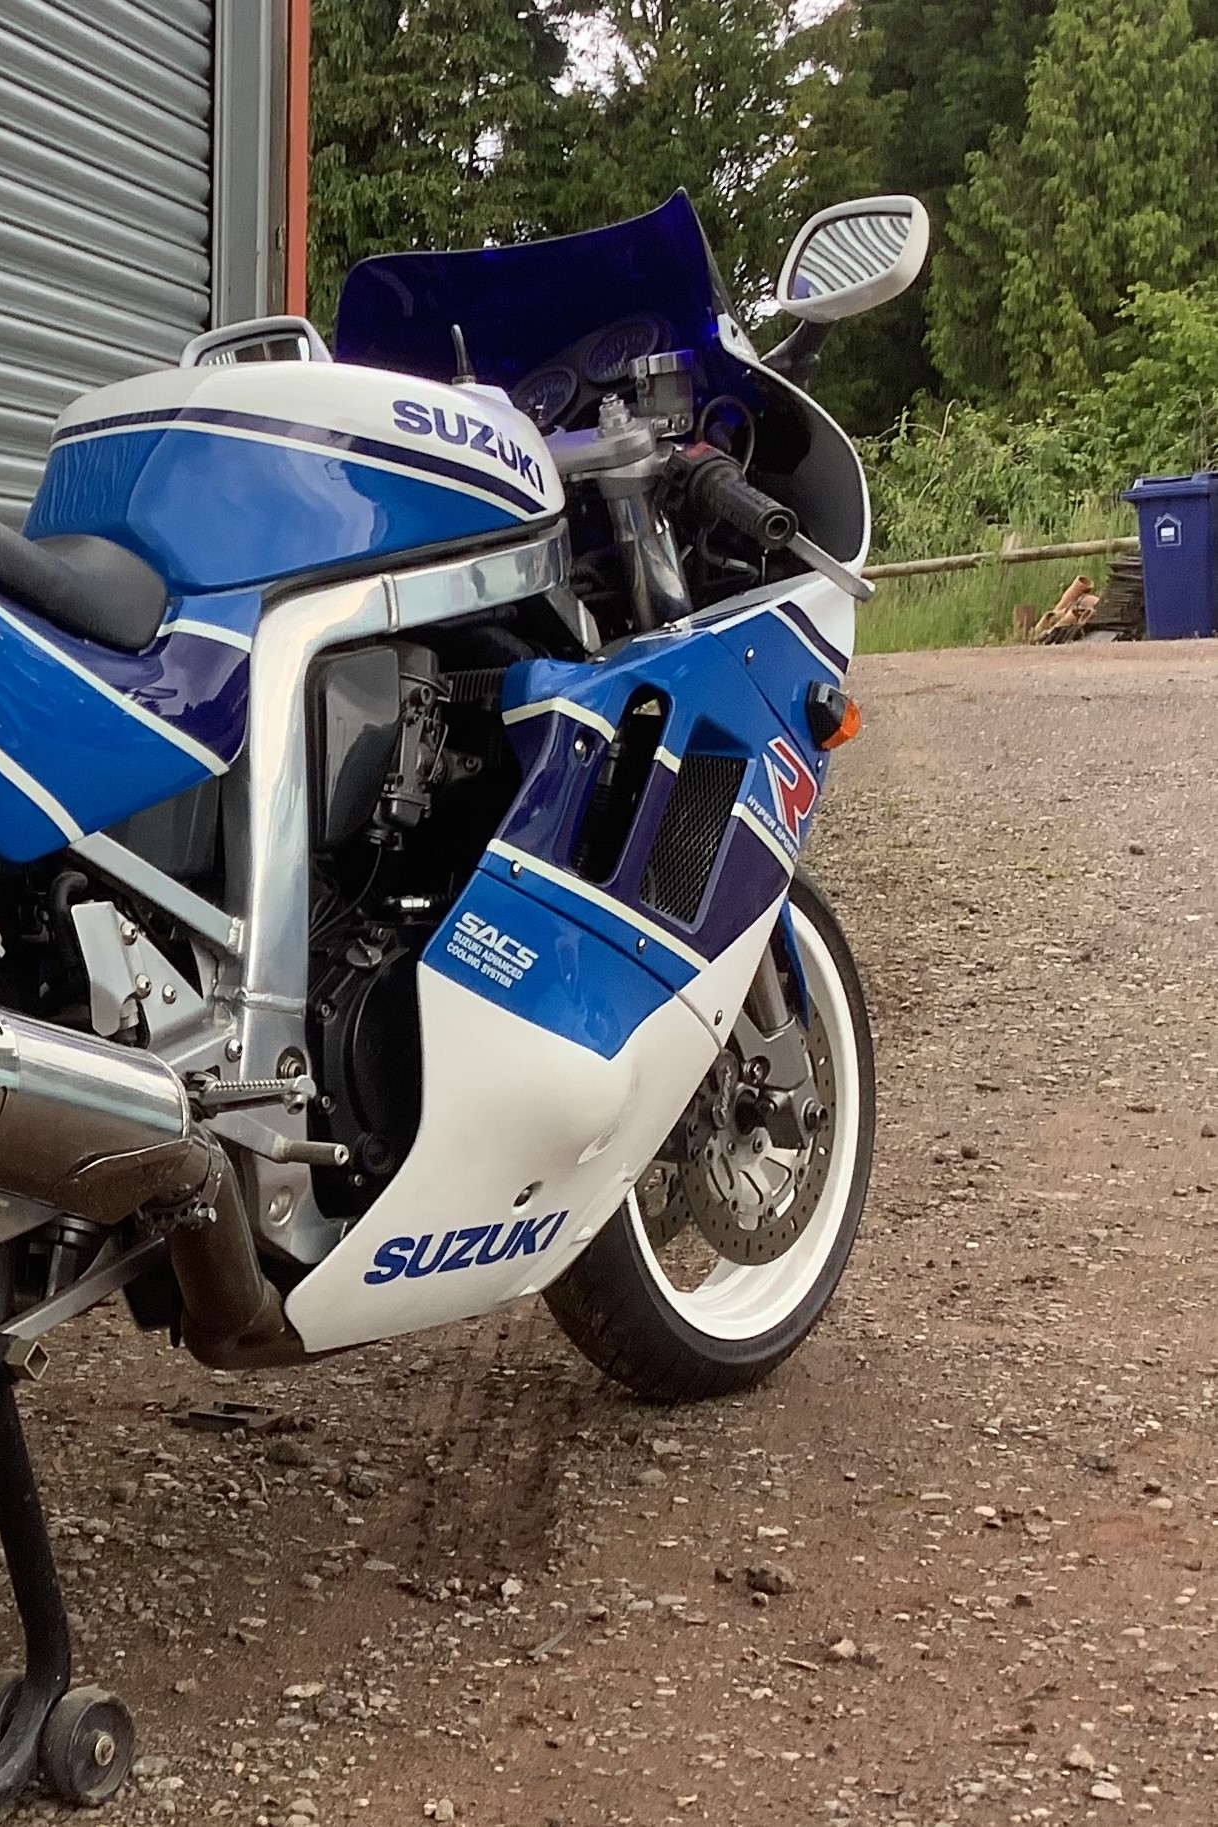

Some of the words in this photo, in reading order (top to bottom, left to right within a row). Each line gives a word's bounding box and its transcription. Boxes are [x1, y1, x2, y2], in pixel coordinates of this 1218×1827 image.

[392, 399, 545, 496] SUZUKI
[747, 794, 777, 831] HYPER
[762, 735, 818, 850] R
[446, 941, 481, 970] COOLING
[480, 962, 513, 989] SYSTEM
[452, 930, 484, 956] SUZUKI
[480, 948, 524, 980] ADVANCED
[454, 911, 539, 970] SACS
[363, 1209, 570, 1285] SUZUKI
